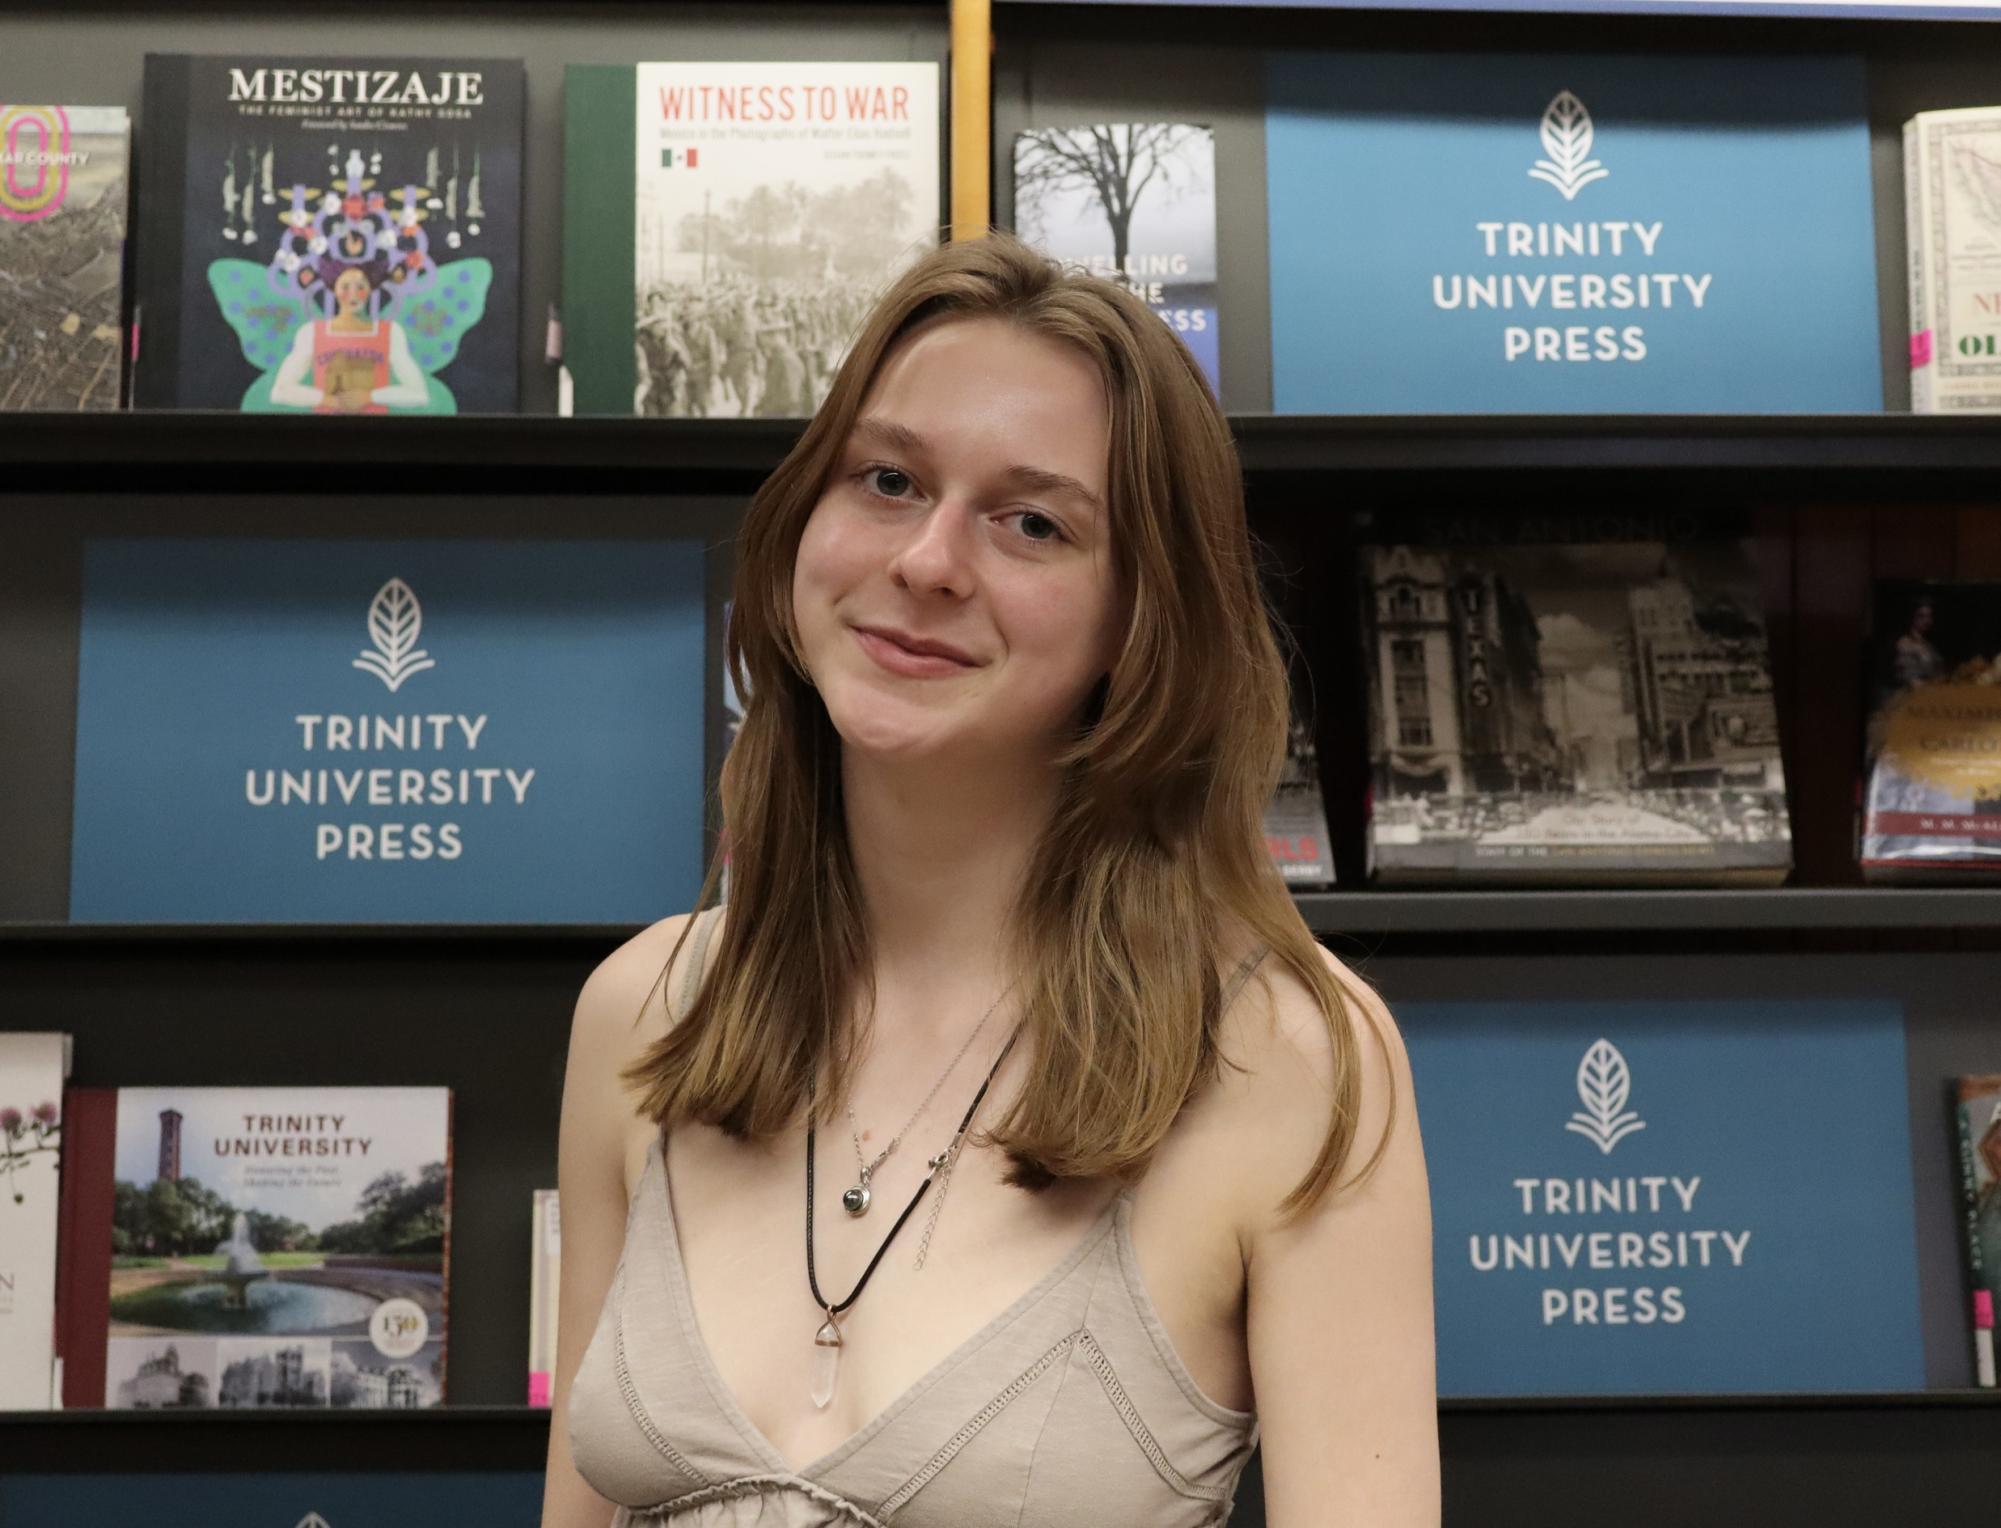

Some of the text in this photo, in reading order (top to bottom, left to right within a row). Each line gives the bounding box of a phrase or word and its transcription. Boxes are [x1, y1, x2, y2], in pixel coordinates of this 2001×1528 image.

[229, 67, 484, 105] MESTIZAJE
[659, 85, 910, 121] WITNESS TO WAR
[1476, 221, 1664, 257] TRINITY
[1432, 273, 1713, 310] UNIVERSITY
[1504, 326, 1648, 362] PRESS
[296, 714, 489, 752] TRINITY
[245, 768, 537, 806] UNIVERSITY
[315, 823, 464, 861] PRESS
[242, 1114, 346, 1133] TRINITY
[213, 1138, 373, 1157] UNIVERSITY
[1513, 1176, 1702, 1214] TRINITY
[1469, 1230, 1752, 1271] UNIVERSITY
[1541, 1287, 1687, 1326] PRESS
